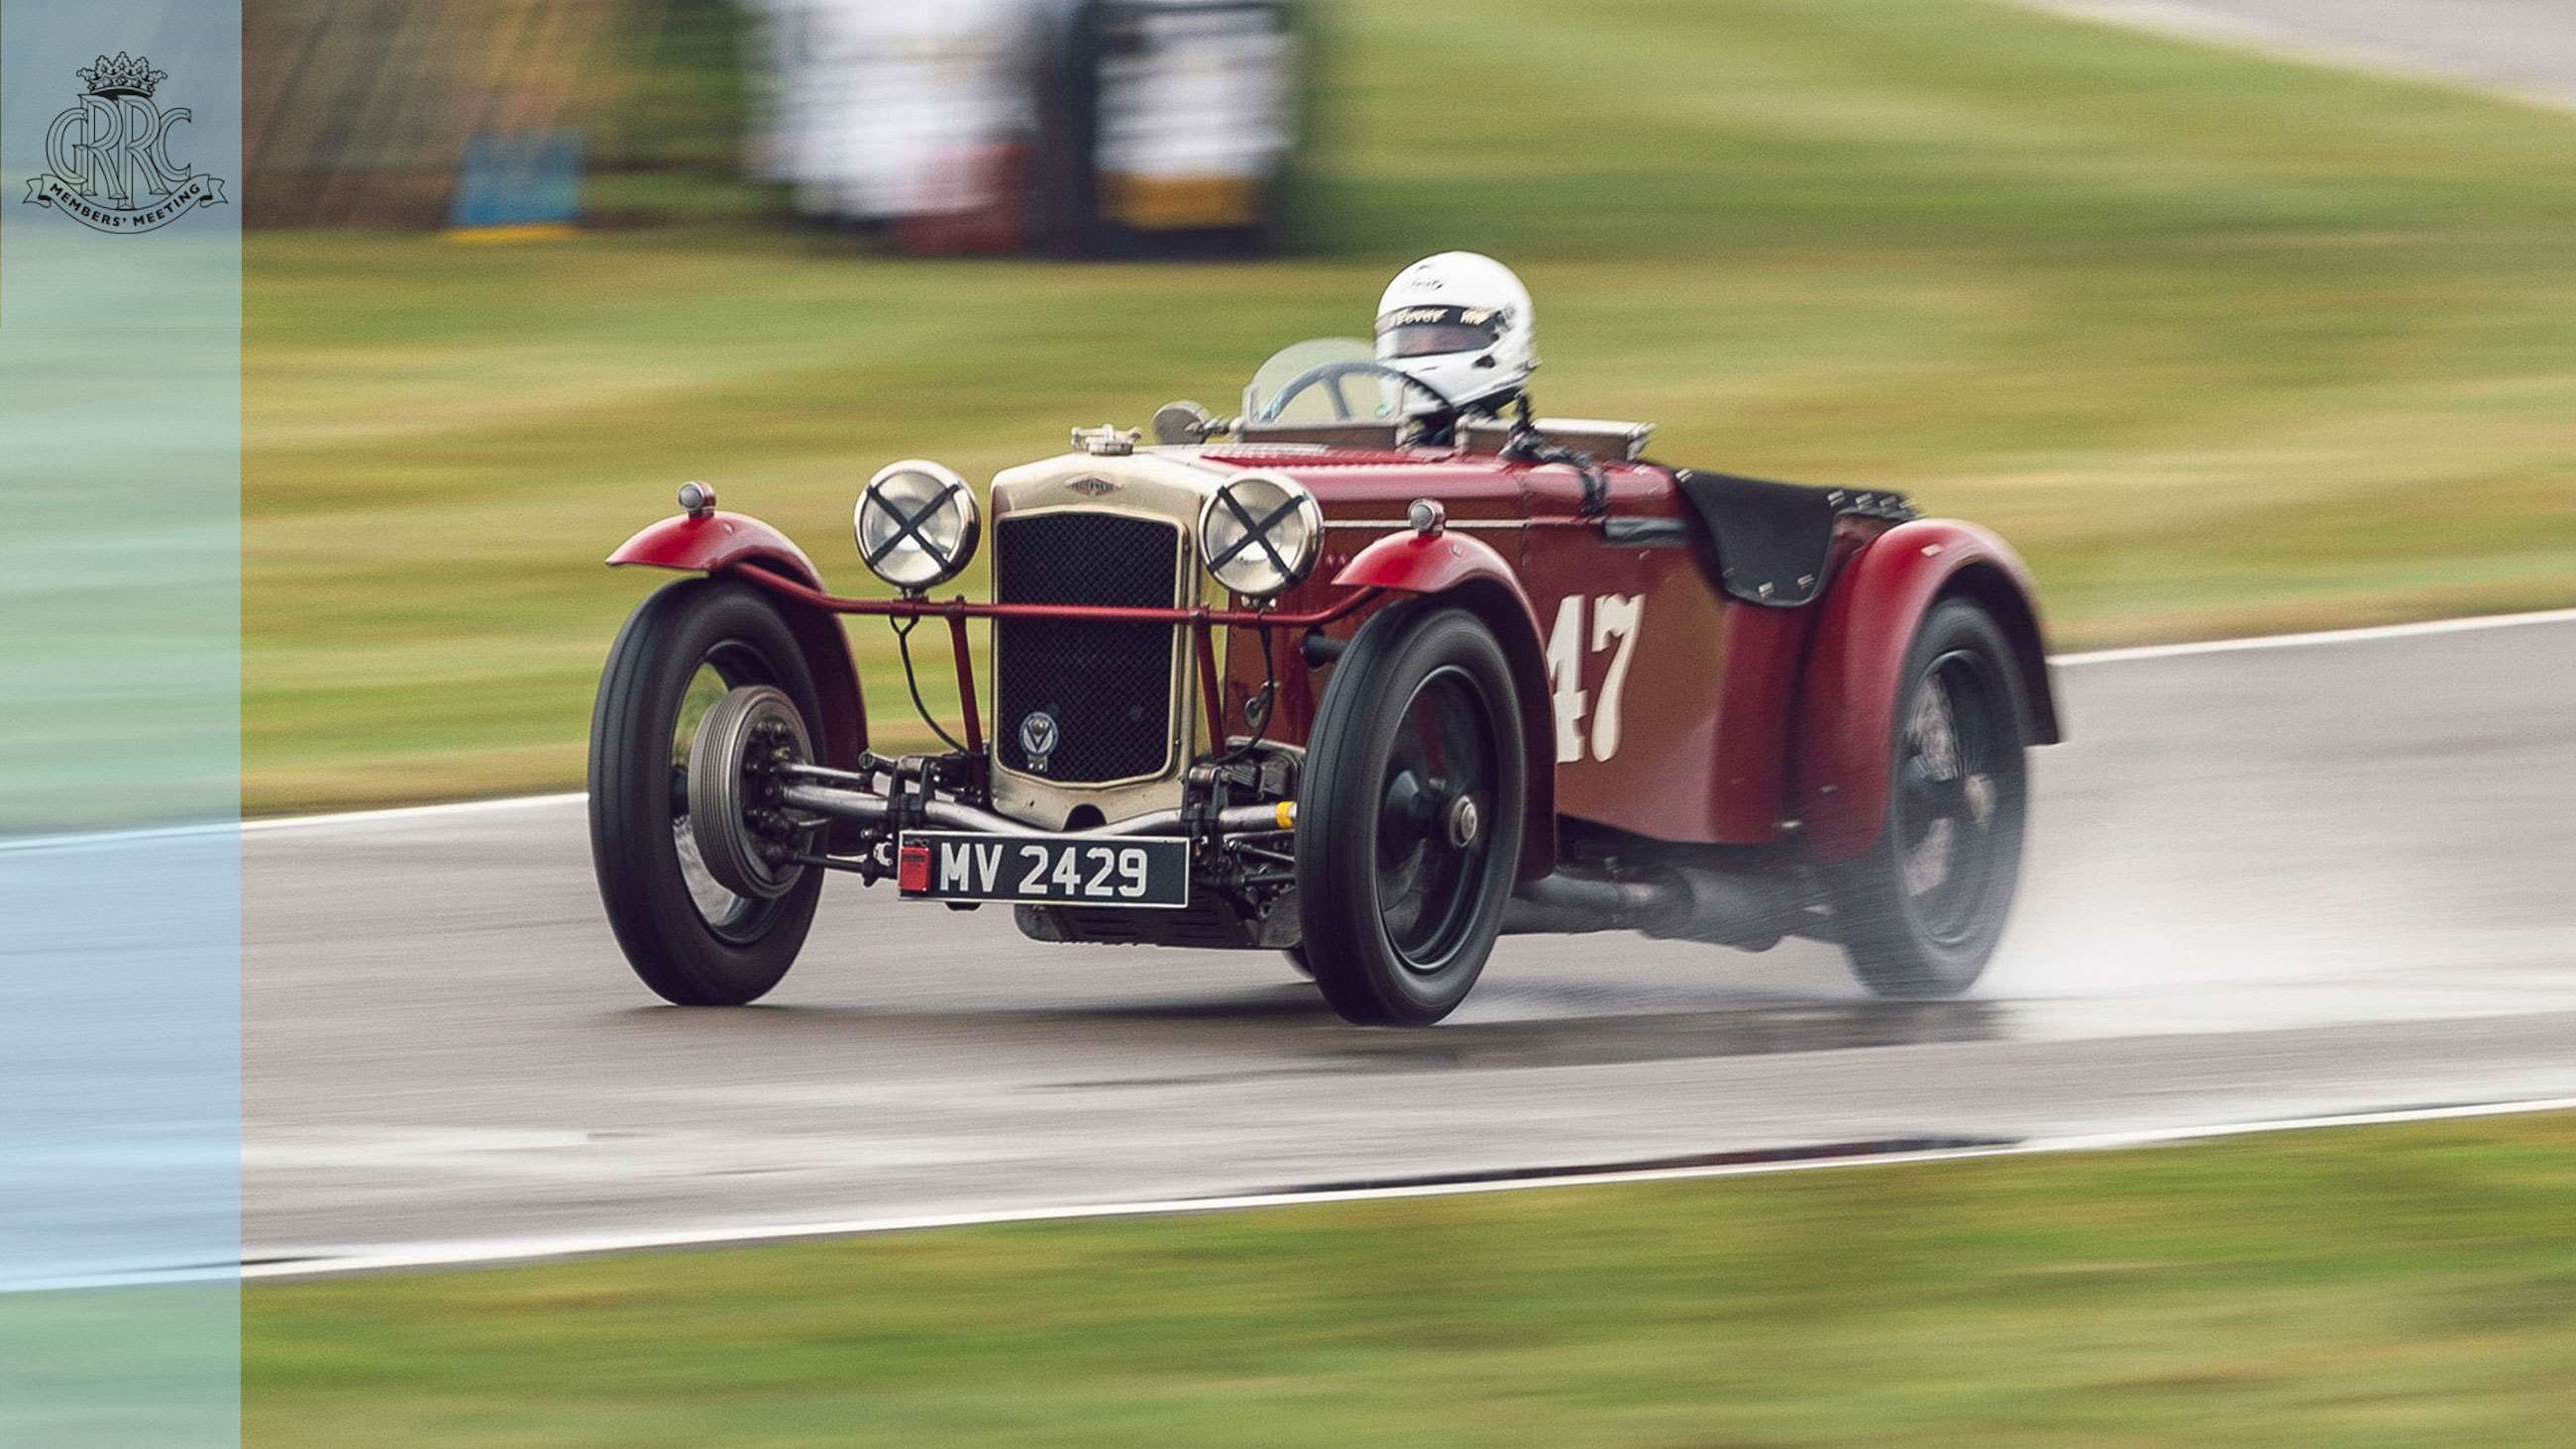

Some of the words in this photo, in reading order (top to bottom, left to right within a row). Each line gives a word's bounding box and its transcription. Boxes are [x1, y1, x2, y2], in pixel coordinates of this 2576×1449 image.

[1546, 593, 1647, 765] 47
[940, 843, 1004, 892] MV
[1018, 846, 1148, 897] 2429
